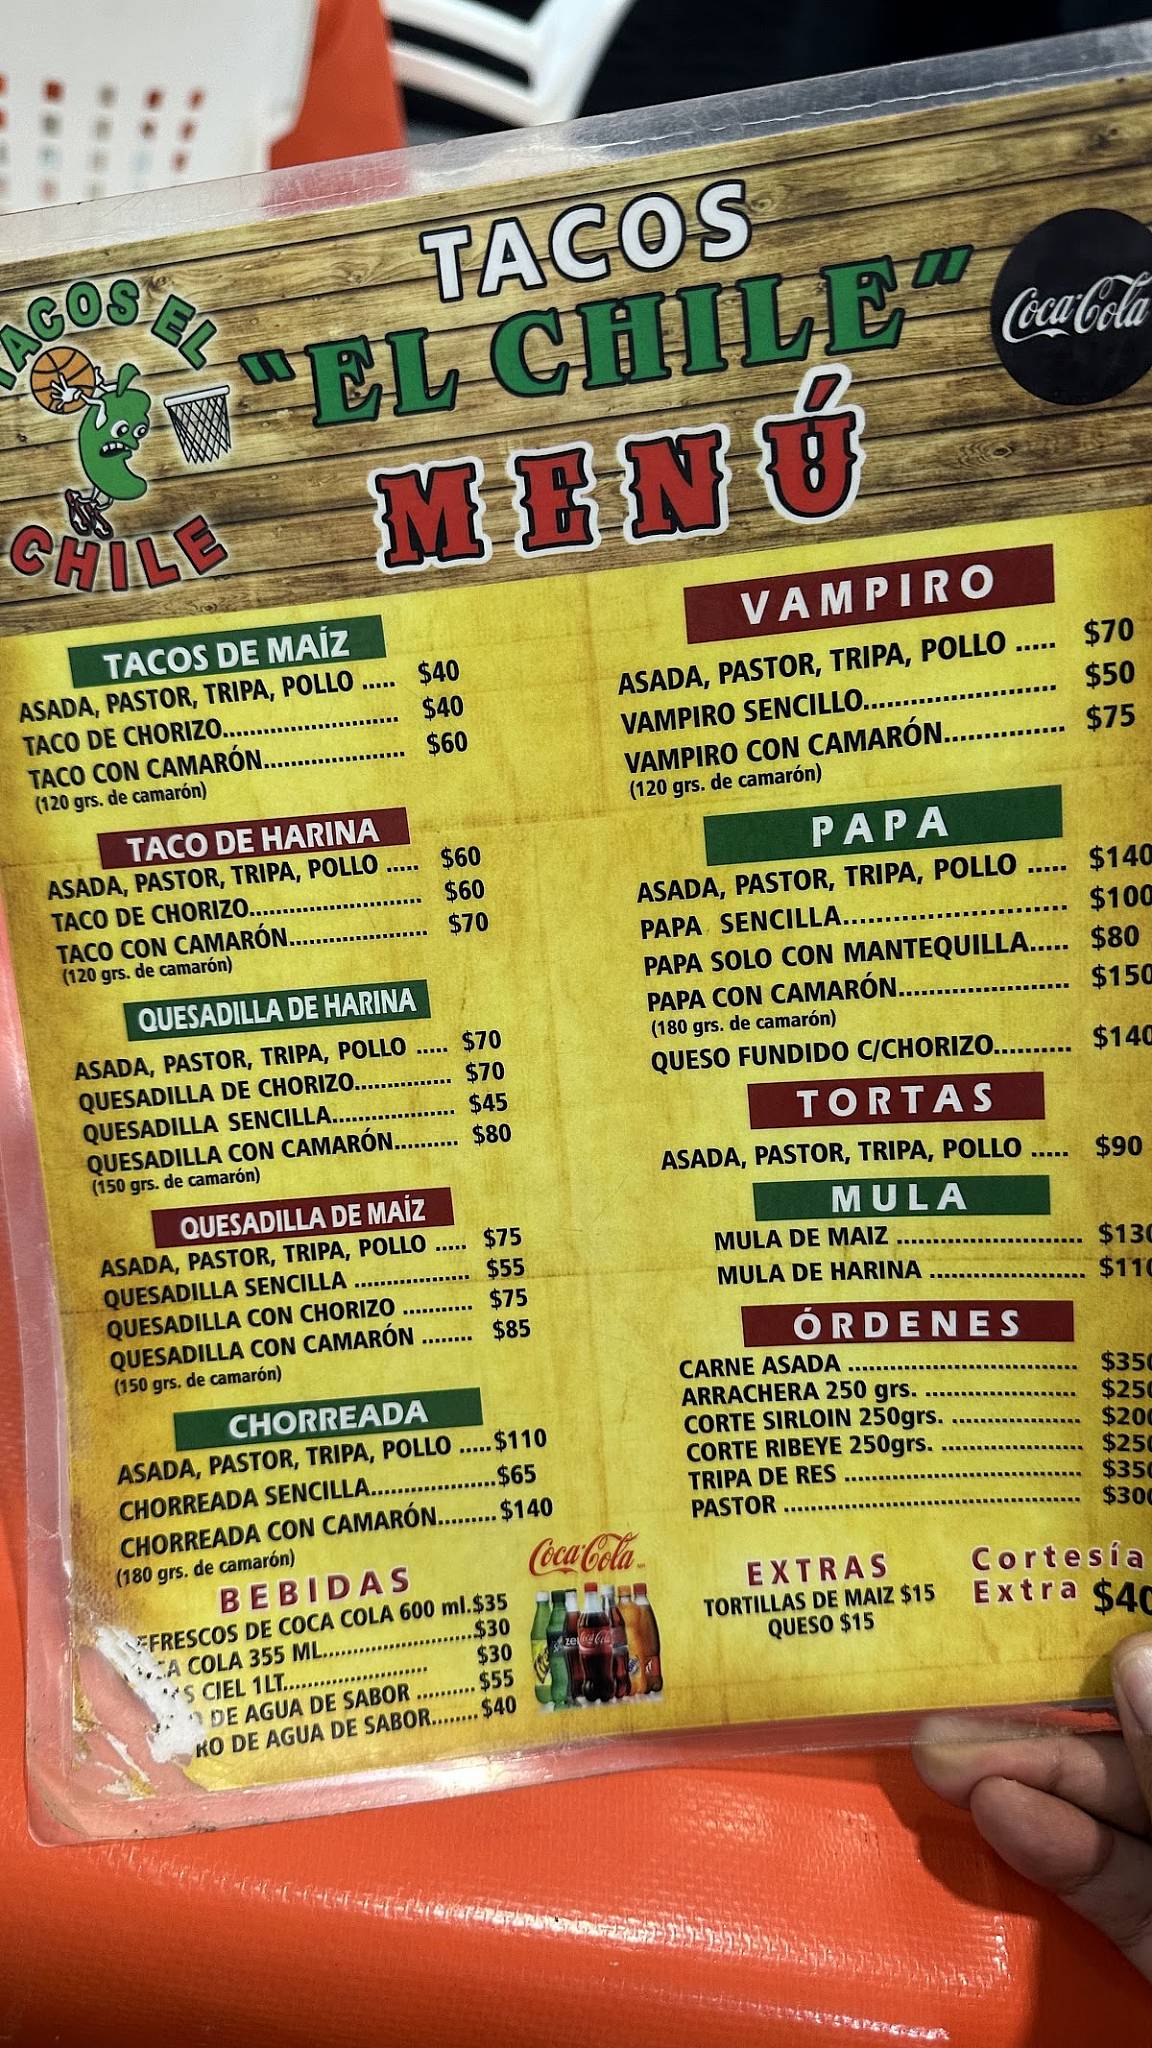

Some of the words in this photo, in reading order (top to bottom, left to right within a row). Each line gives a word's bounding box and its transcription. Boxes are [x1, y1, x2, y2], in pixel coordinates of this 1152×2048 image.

[420, 179, 751, 302] TACOS
[0, 280, 139, 390] ACOS
[152, 294, 218, 370] EL
[370, 365, 864, 572] MENÚ
[10, 516, 228, 592] CHILE
[740, 564, 994, 625] VAMPIRO
[102, 644, 209, 680] TACOS
[216, 639, 260, 669] DE
[267, 630, 350, 664] MAÍZ
[618, 664, 710, 696] ASADA,
[718, 652, 822, 685] PASTOR,
[829, 642, 912, 672] TRIPA,
[921, 630, 1006, 662] POLLO
[1083, 617, 1134, 648] $70
[19, 696, 100, 724] ASADA,
[105, 686, 198, 714] PASTOR,
[202, 678, 275, 705] TRIPA,
[281, 670, 354, 698] POLLO
[417, 659, 460, 687] $40
[620, 702, 736, 735] VAMPIRO
[1085, 659, 1135, 690] $50
[21, 731, 80, 757] TACO
[86, 728, 118, 751] DE
[422, 695, 464, 722] $40
[623, 742, 738, 774] VAMPIRO
[746, 735, 800, 763] CON
[1086, 702, 1136, 733] $75
[27, 765, 86, 790] TACO
[92, 760, 140, 784] CON
[426, 730, 468, 757] $60
[35, 794, 70, 815] (120
[73, 795, 104, 813] grs.
[107, 788, 128, 806] de
[132, 780, 207, 804] camarón)
[629, 778, 668, 801] (120
[672, 779, 706, 799] grs.
[710, 772, 733, 791] de
[737, 762, 822, 788] camarón)
[126, 832, 208, 862] TACO
[215, 828, 255, 856] DE
[261, 817, 381, 852] HARINA
[812, 806, 949, 848] PAPA
[440, 845, 481, 871] $60
[1089, 842, 1152, 872] $140
[444, 878, 485, 904] $60
[1089, 883, 1152, 913] $100
[448, 911, 489, 937] $70
[1090, 924, 1140, 952] $80
[1091, 962, 1152, 991] $150
[138, 998, 284, 1033] QUESADILLA
[287, 995, 319, 1021] DE
[323, 987, 417, 1018] HARINA
[1092, 1023, 1152, 1051] $140
[74, 1057, 155, 1081] ASADA,
[163, 1049, 253, 1074] PASTOR,
[260, 1043, 329, 1066] TRIPA,
[337, 1036, 407, 1061] POLLO
[461, 1029, 502, 1053] $70
[465, 1061, 505, 1085] $70
[468, 1092, 508, 1116] $45
[796, 1082, 992, 1118] TORTAS
[472, 1123, 512, 1147] $80
[661, 1146, 747, 1171] ASADA,
[754, 1142, 851, 1166] PASTOR,
[857, 1139, 934, 1163] TRIPA,
[942, 1137, 1022, 1159] POLLO
[1095, 1133, 1143, 1160] $90
[92, 1178, 126, 1197] (150
[129, 1179, 160, 1196] grs.
[163, 1173, 184, 1189] de
[188, 1166, 261, 1187] camarón)
[832, 1182, 967, 1213] MULA
[180, 1206, 327, 1240] QUESADILLA
[330, 1203, 362, 1228] DE
[367, 1198, 426, 1225] MAÍZ
[483, 1227, 522, 1250] $75
[714, 1229, 783, 1251] MULA
[789, 1227, 821, 1248] DE
[827, 1225, 889, 1247] MAIZ
[103, 1279, 239, 1312] QUESADILLA
[244, 1270, 348, 1297] SENCILLA
[486, 1257, 525, 1281] $55
[717, 1263, 786, 1286] MULA
[791, 1262, 823, 1282] DE
[830, 1259, 923, 1281] HARINA
[106, 1310, 242, 1342] QUESADILLA
[247, 1305, 294, 1328] CON
[300, 1297, 395, 1323] CHORIZO
[489, 1287, 528, 1311] $75
[793, 1306, 1019, 1341] ÓRDENES
[109, 1341, 245, 1373] QUESADILLA
[250, 1336, 296, 1358] CON
[303, 1322, 414, 1354] CAMARÓN
[492, 1318, 531, 1342] $85
[679, 1356, 755, 1379] CARNE
[761, 1353, 842, 1375] ASADA
[681, 1381, 820, 1407] ARRACHERA
[825, 1379, 867, 1400] 250
[874, 1383, 917, 1404] grs.
[229, 1399, 429, 1439] CHORREADA
[683, 1412, 756, 1435] CORTE
[762, 1407, 852, 1431] SIRLOIN
[859, 1406, 944, 1431] 250grs.
[116, 1458, 202, 1486] ASADA,
[209, 1448, 299, 1476] PASTOR,
[305, 1442, 375, 1466] TRIPA,
[382, 1435, 452, 1460] POLLO
[686, 1439, 759, 1463] CORTE
[765, 1435, 842, 1458] RIBEYE
[849, 1434, 933, 1458] 250grs.
[687, 1468, 753, 1491] TRIPA
[758, 1466, 789, 1487] DE
[795, 1463, 837, 1485] RES
[119, 1488, 259, 1522] CHORREADA
[691, 1494, 777, 1519] PASTOR
[120, 1523, 262, 1559] CHORREADA
[267, 1517, 315, 1542] CON
[500, 1497, 553, 1523] $140
[116, 1566, 153, 1589] (180
[157, 1566, 189, 1586] grs.
[193, 1559, 214, 1577] de
[219, 1548, 295, 1574] camarón)
[747, 1552, 887, 1586] EXTRAS
[971, 1541, 1144, 1571] Cortesía
[220, 1566, 409, 1614] BEBIDAS
[703, 1591, 806, 1617] TORTILLAS
[812, 1589, 839, 1610] DE
[844, 1586, 895, 1607] MAIZ
[900, 1583, 935, 1605] $15
[973, 1578, 1077, 1604] Extra
[245, 1619, 272, 1641] DE
[278, 1612, 335, 1636] COCA
[340, 1604, 394, 1628] COLA
[399, 1599, 435, 1621] 600
[768, 1614, 834, 1640] QUESO
[839, 1611, 875, 1633] $15
[188, 1651, 243, 1675] COLA
[249, 1645, 285, 1668] 355
[476, 1643, 513, 1666] $30
[202, 1678, 246, 1700] CIEL
[479, 1668, 514, 1693] $55
[481, 1695, 517, 1720] $40
